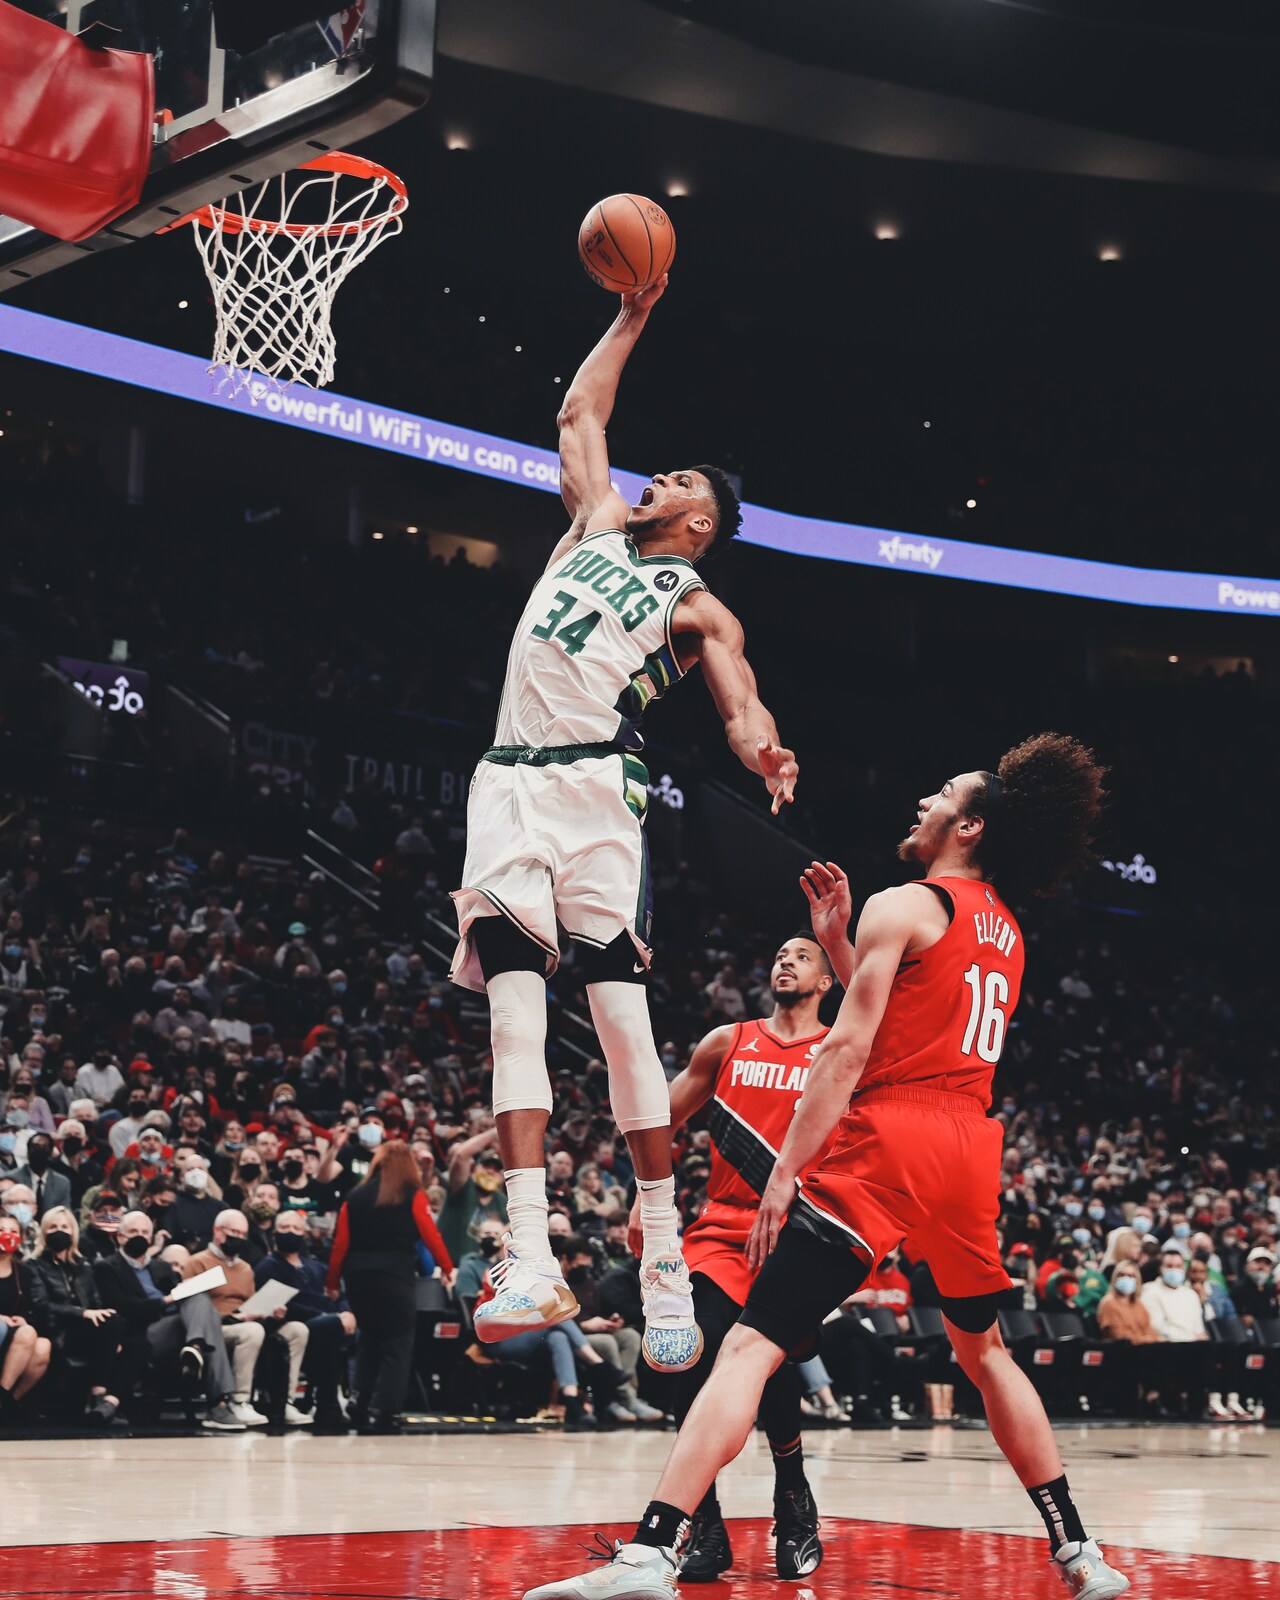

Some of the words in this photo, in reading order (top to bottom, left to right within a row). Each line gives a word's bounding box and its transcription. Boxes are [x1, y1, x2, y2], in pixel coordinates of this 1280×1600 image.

[251, 381, 362, 434] Powerful
[368, 411, 422, 449] WiFi
[425, 433, 469, 460] you
[473, 446, 517, 474] can
[878, 536, 943, 570] xfinity
[530, 590, 602, 656] 34
[553, 549, 660, 633] BUCKS
[974, 911, 1017, 958] ELLEBY
[961, 963, 1009, 1063] 16
[656, 1258, 684, 1273] MVP
